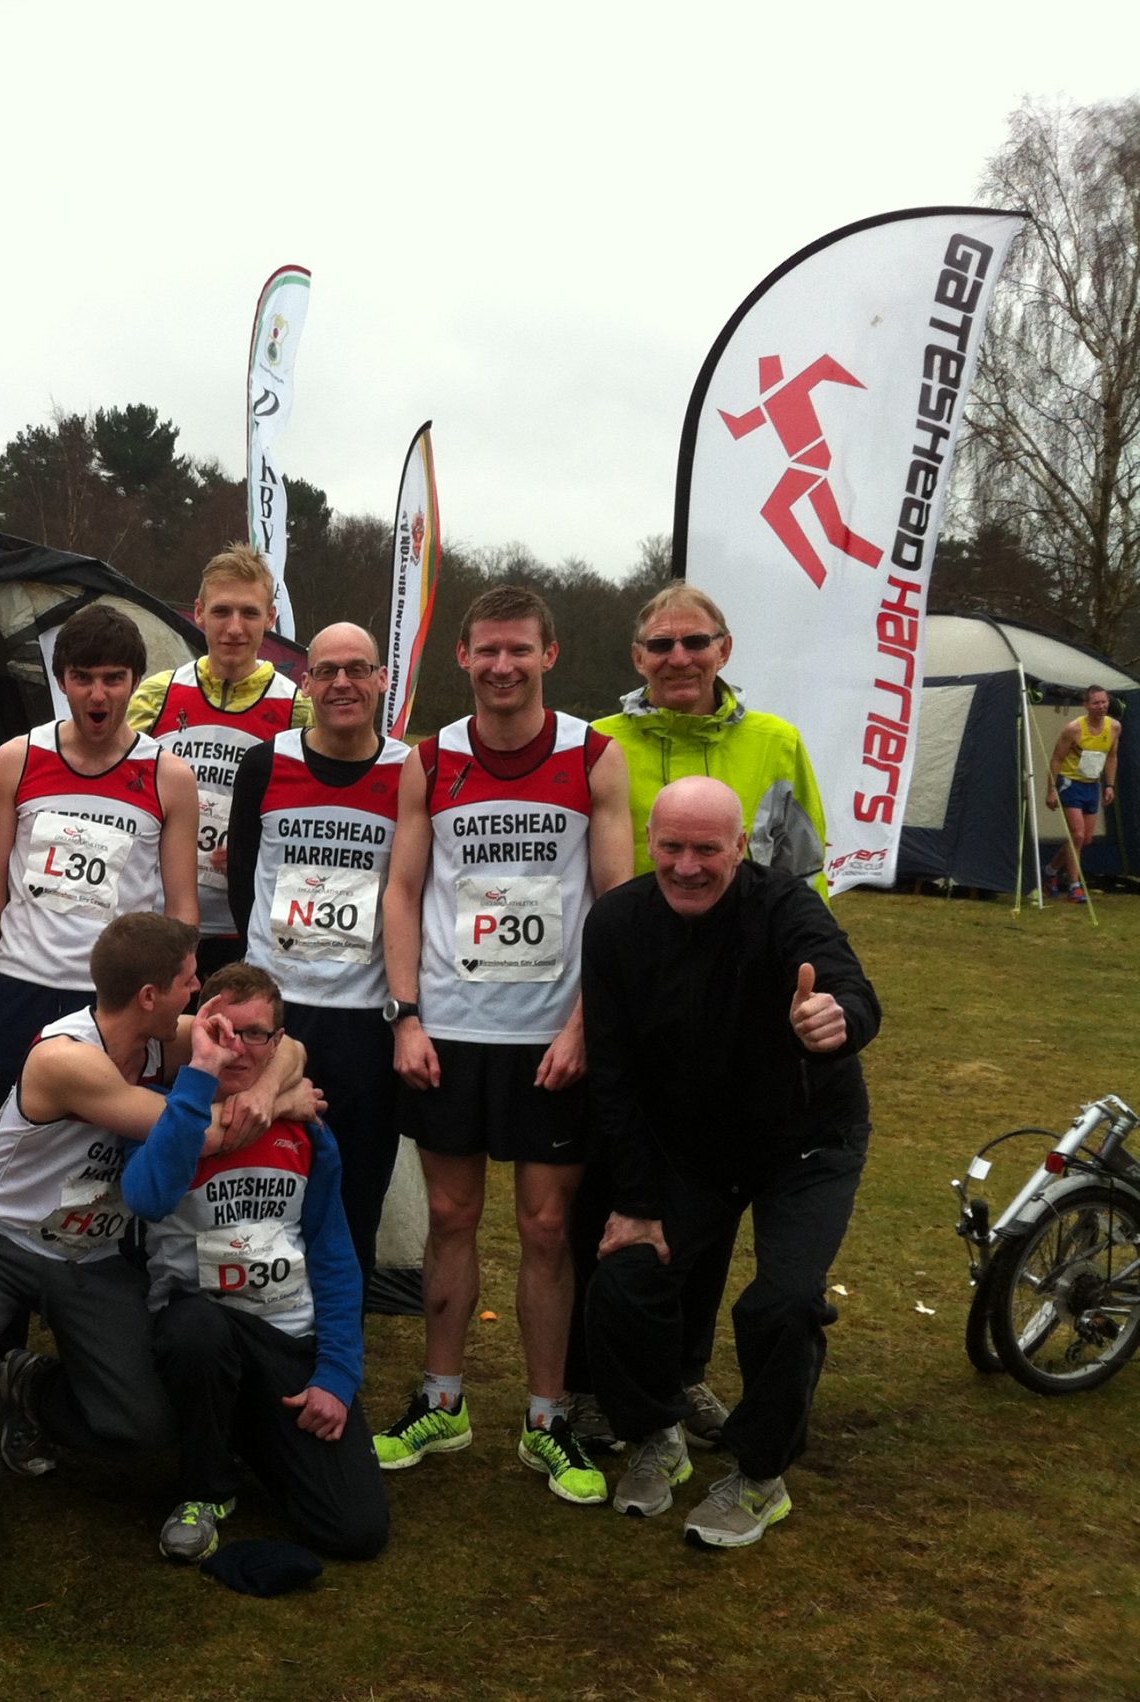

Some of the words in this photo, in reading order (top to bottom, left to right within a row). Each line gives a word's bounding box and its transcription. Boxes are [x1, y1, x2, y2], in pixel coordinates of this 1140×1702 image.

[254, 388, 279, 555] DRBY
[398, 536, 410, 596] BILSTON
[394, 600, 405, 629] AND
[172, 741, 246, 764] GATESHE
[278, 818, 386, 845] GATESHEAD
[453, 813, 567, 837] GATESHEAD
[44, 847, 106, 885] L30
[284, 845, 374, 870] HARRIERS
[462, 841, 558, 864] HARRIERS
[288, 900, 358, 931] N30
[473, 915, 544, 945] P30
[206, 1177, 297, 1203] GATESHEAD
[61, 1211, 123, 1238] H30
[214, 1200, 287, 1226] HARRIERS
[219, 1257, 291, 1290] D30
